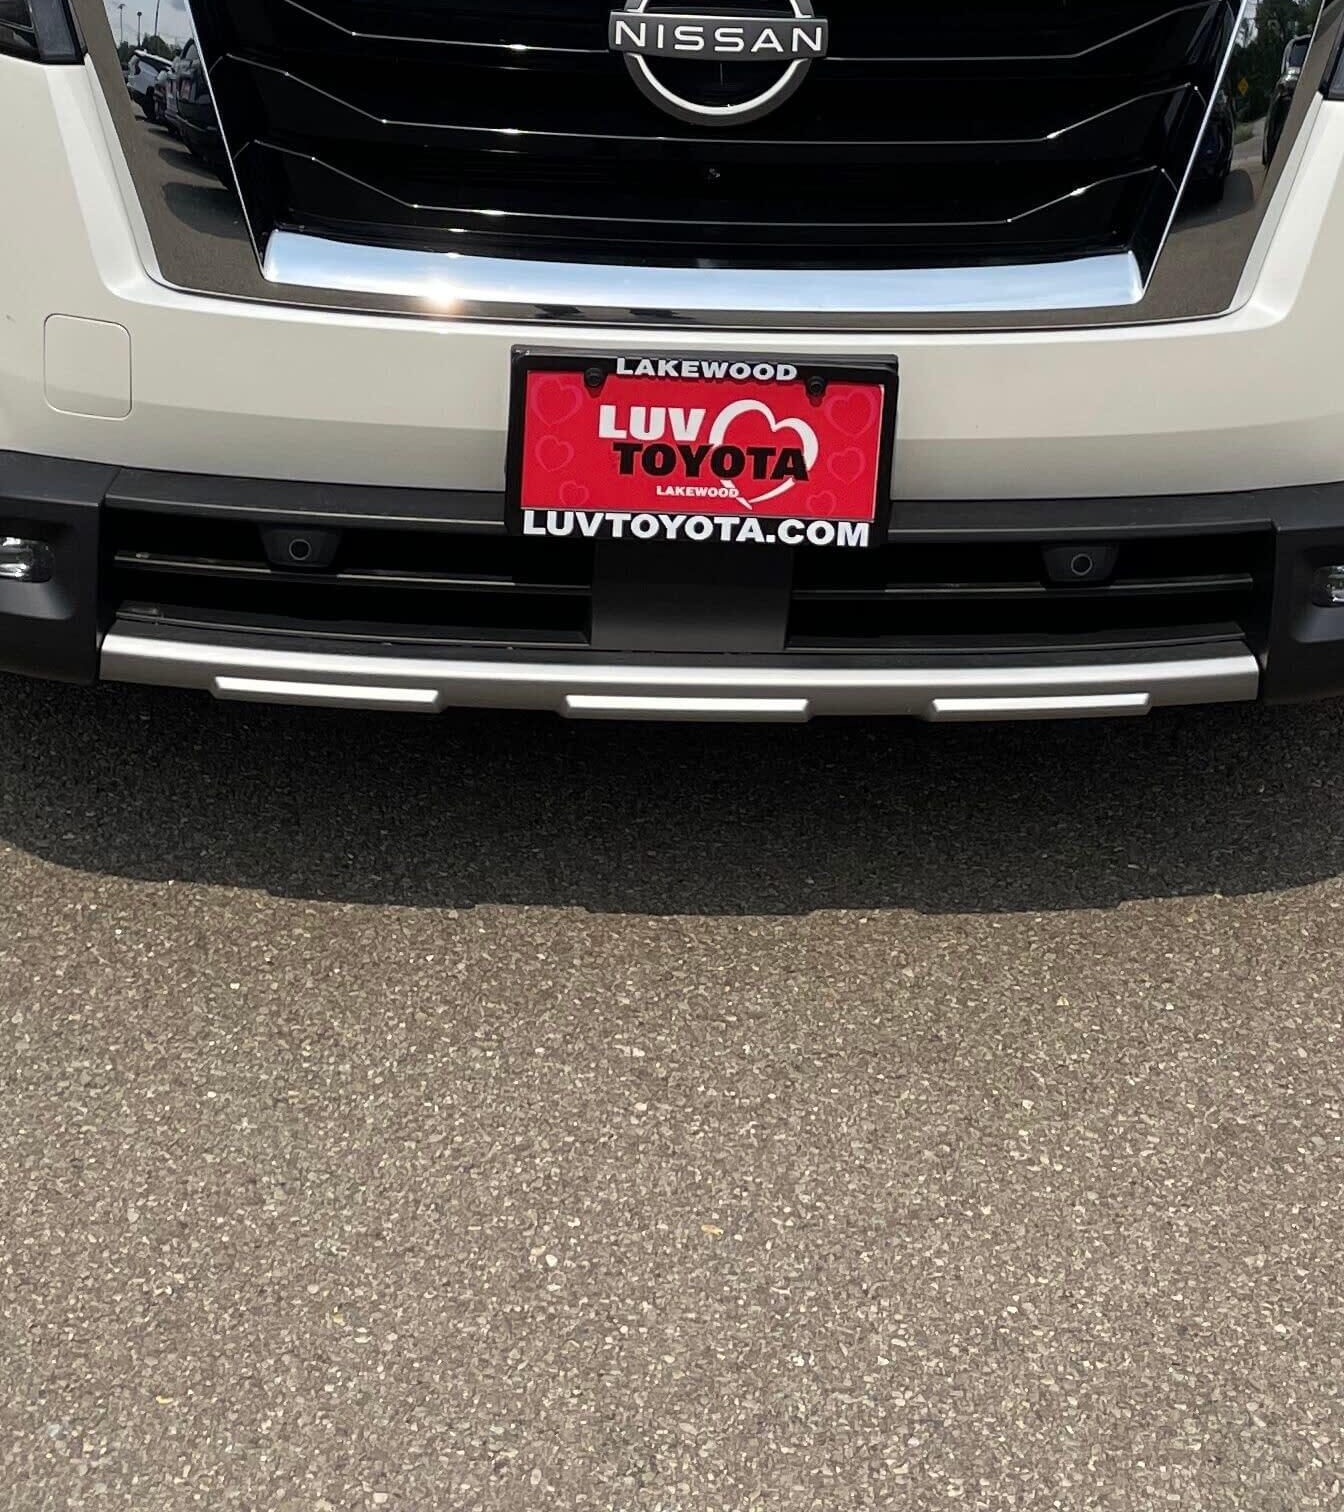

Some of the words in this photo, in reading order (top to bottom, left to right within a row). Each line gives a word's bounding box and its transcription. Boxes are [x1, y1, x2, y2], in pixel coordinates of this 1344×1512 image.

[615, 20, 823, 53] NISSAN
[616, 357, 798, 381] LAKEWOOD
[598, 404, 707, 442] LUV
[613, 442, 809, 482] TOYOTA
[656, 485, 740, 499] LAKEWOOD
[522, 509, 870, 548] LUVTOYOTA.COM
